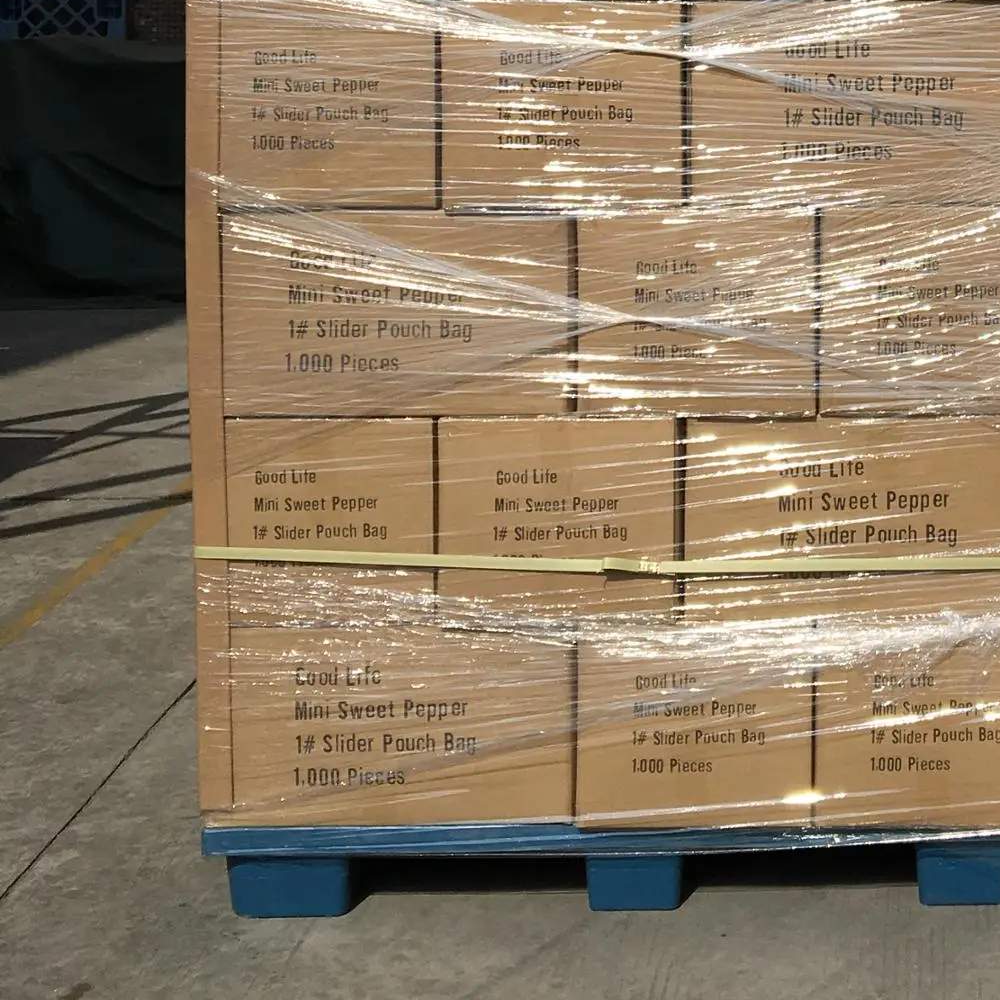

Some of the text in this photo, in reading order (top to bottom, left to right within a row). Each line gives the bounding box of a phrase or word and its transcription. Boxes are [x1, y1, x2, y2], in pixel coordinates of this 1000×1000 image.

[288, 319, 472, 342] 1# Slider Pouch Bag
[341, 353, 399, 372] Pieces
[255, 470, 316, 485] Good Life
[496, 470, 557, 485] Good Life
[254, 497, 378, 512] Mini Sweet Pepper
[252, 524, 387, 540] 1# Slider Pouch Bag
[493, 525, 627, 542] 1# Slider Pouch Bag
[294, 700, 468, 721] Mini Sweet Pepper
[295, 732, 476, 755] 1# Slider Pouch Bag
[632, 729, 765, 746] 1# Slider Pouch Bag
[669, 758, 712, 774] Pieces
